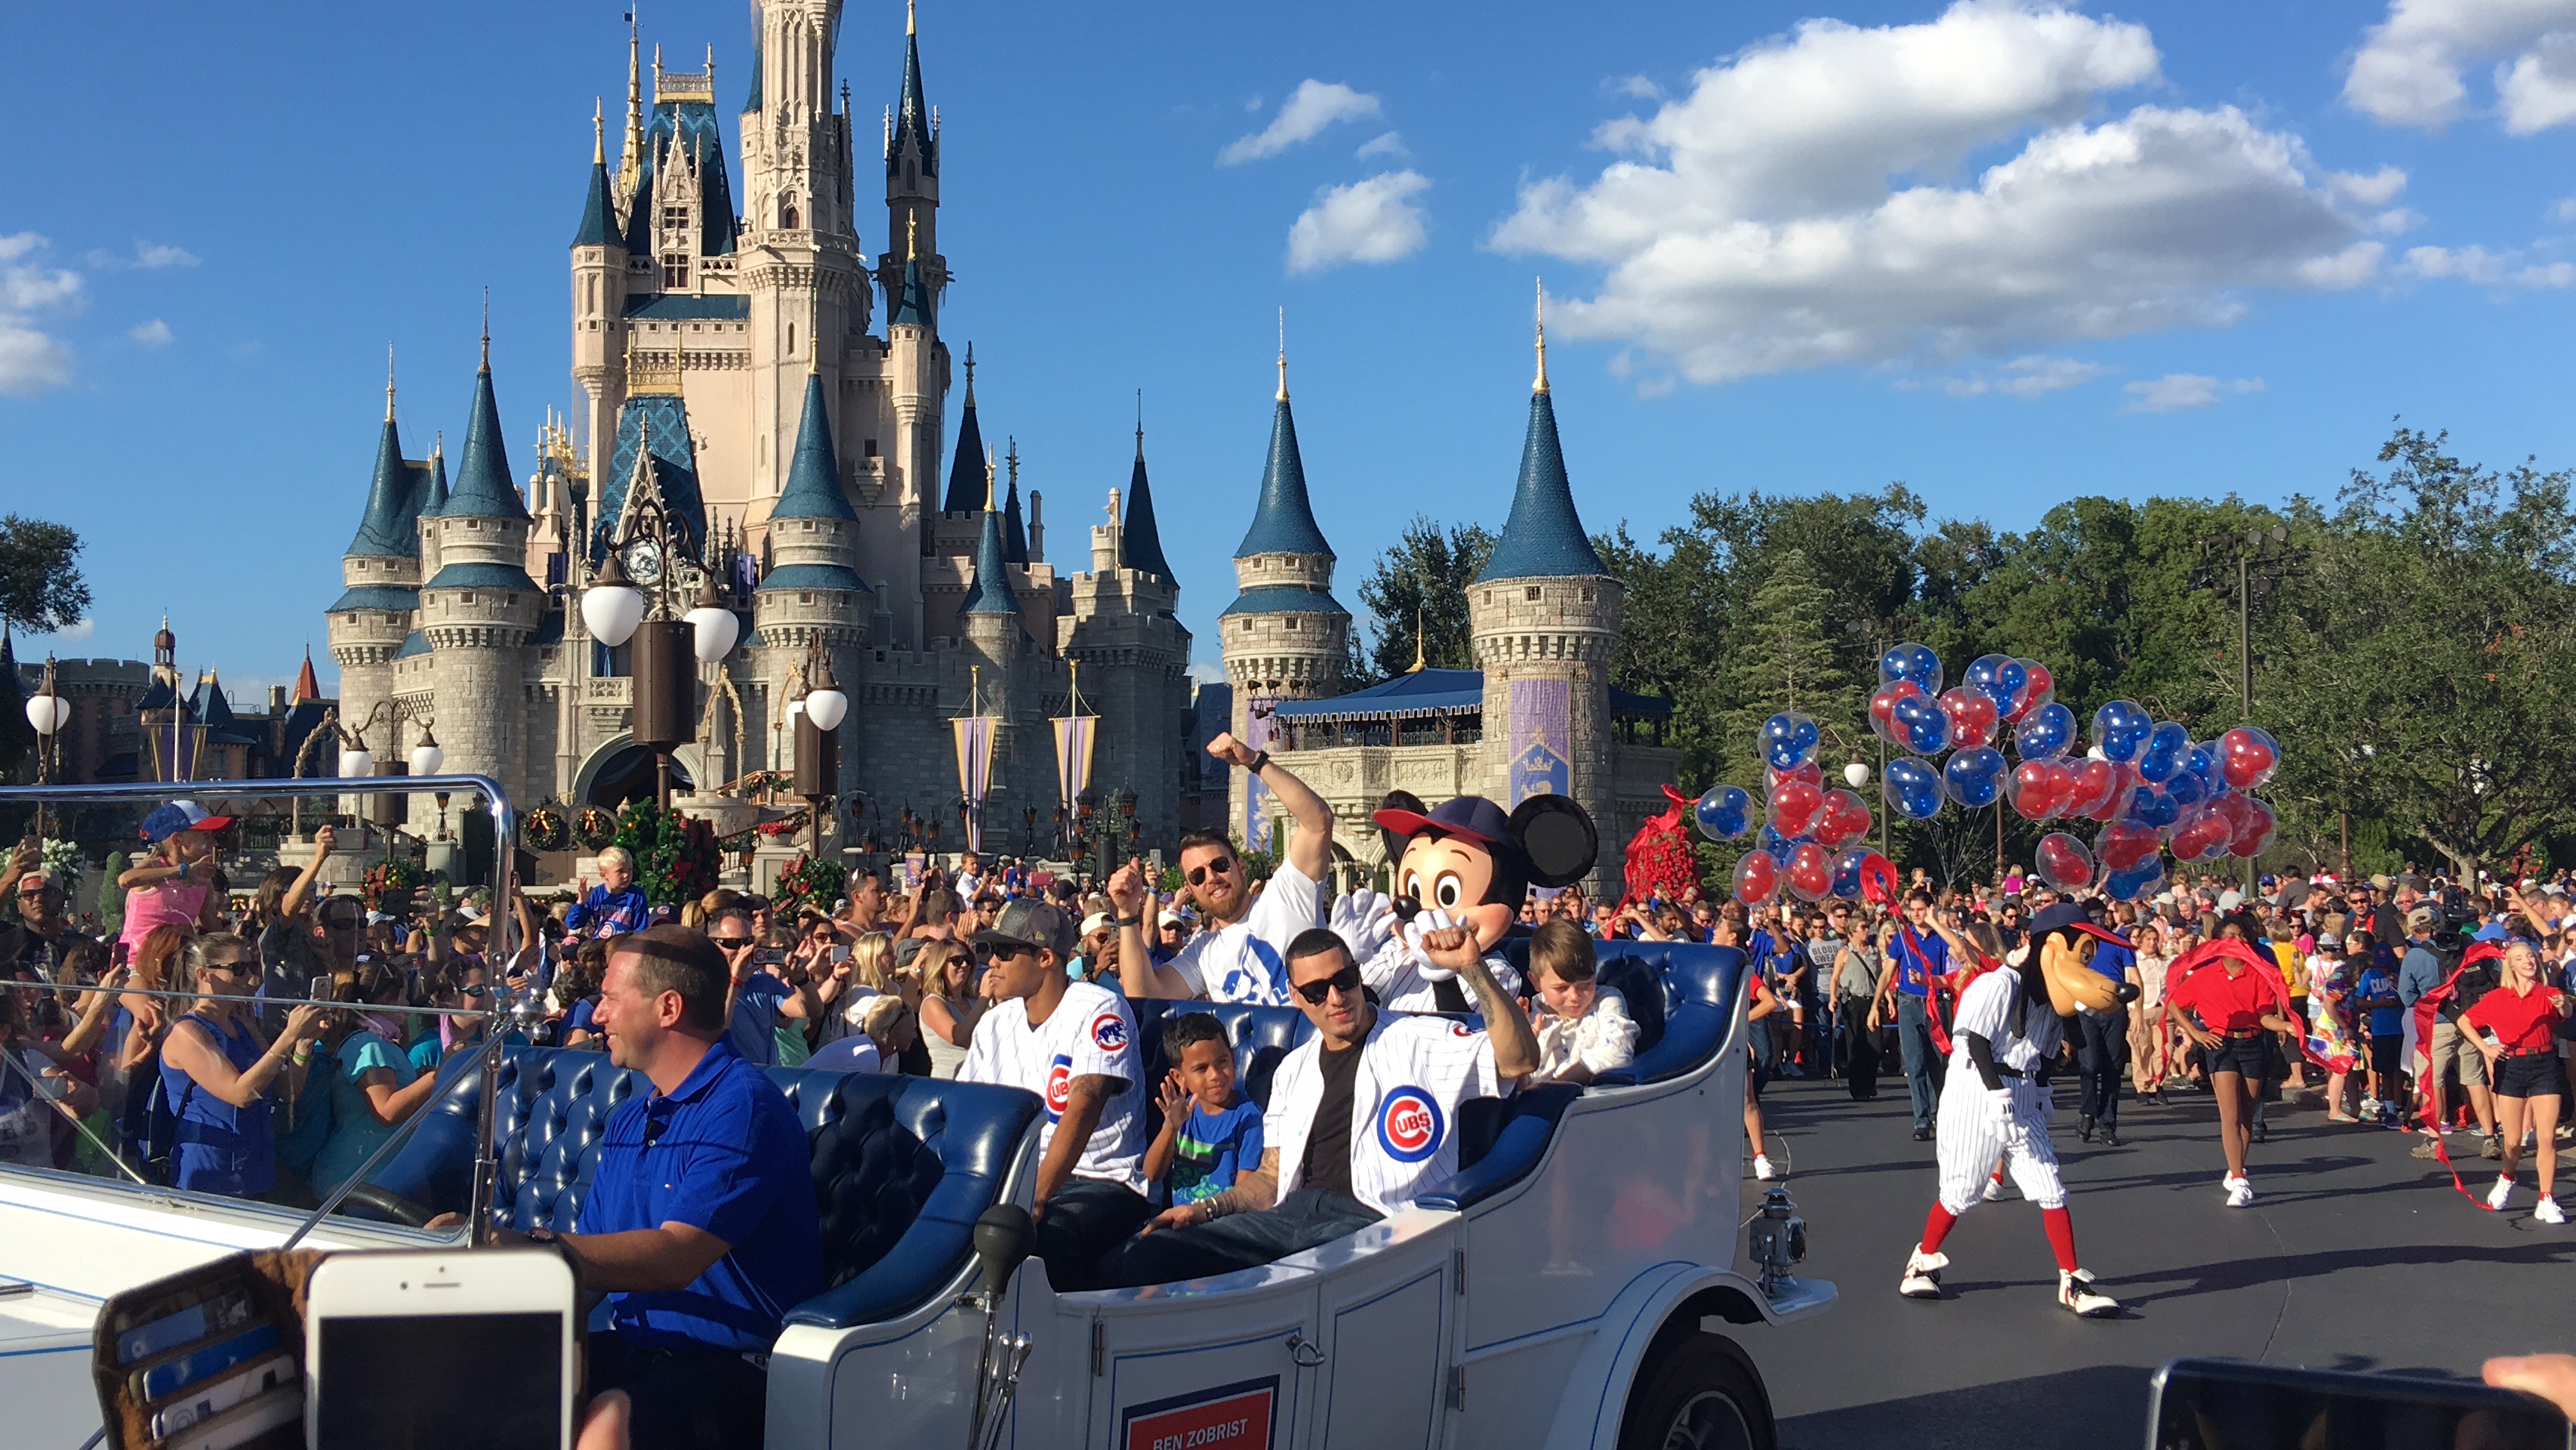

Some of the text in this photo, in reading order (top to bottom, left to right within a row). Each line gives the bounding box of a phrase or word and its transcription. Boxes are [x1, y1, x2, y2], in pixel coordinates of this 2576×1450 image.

[1811, 946, 1838, 955] BLOOD
[1814, 953, 1836, 963] SWEA
[1153, 1418, 1248, 1450] BEN ZOBRIST
